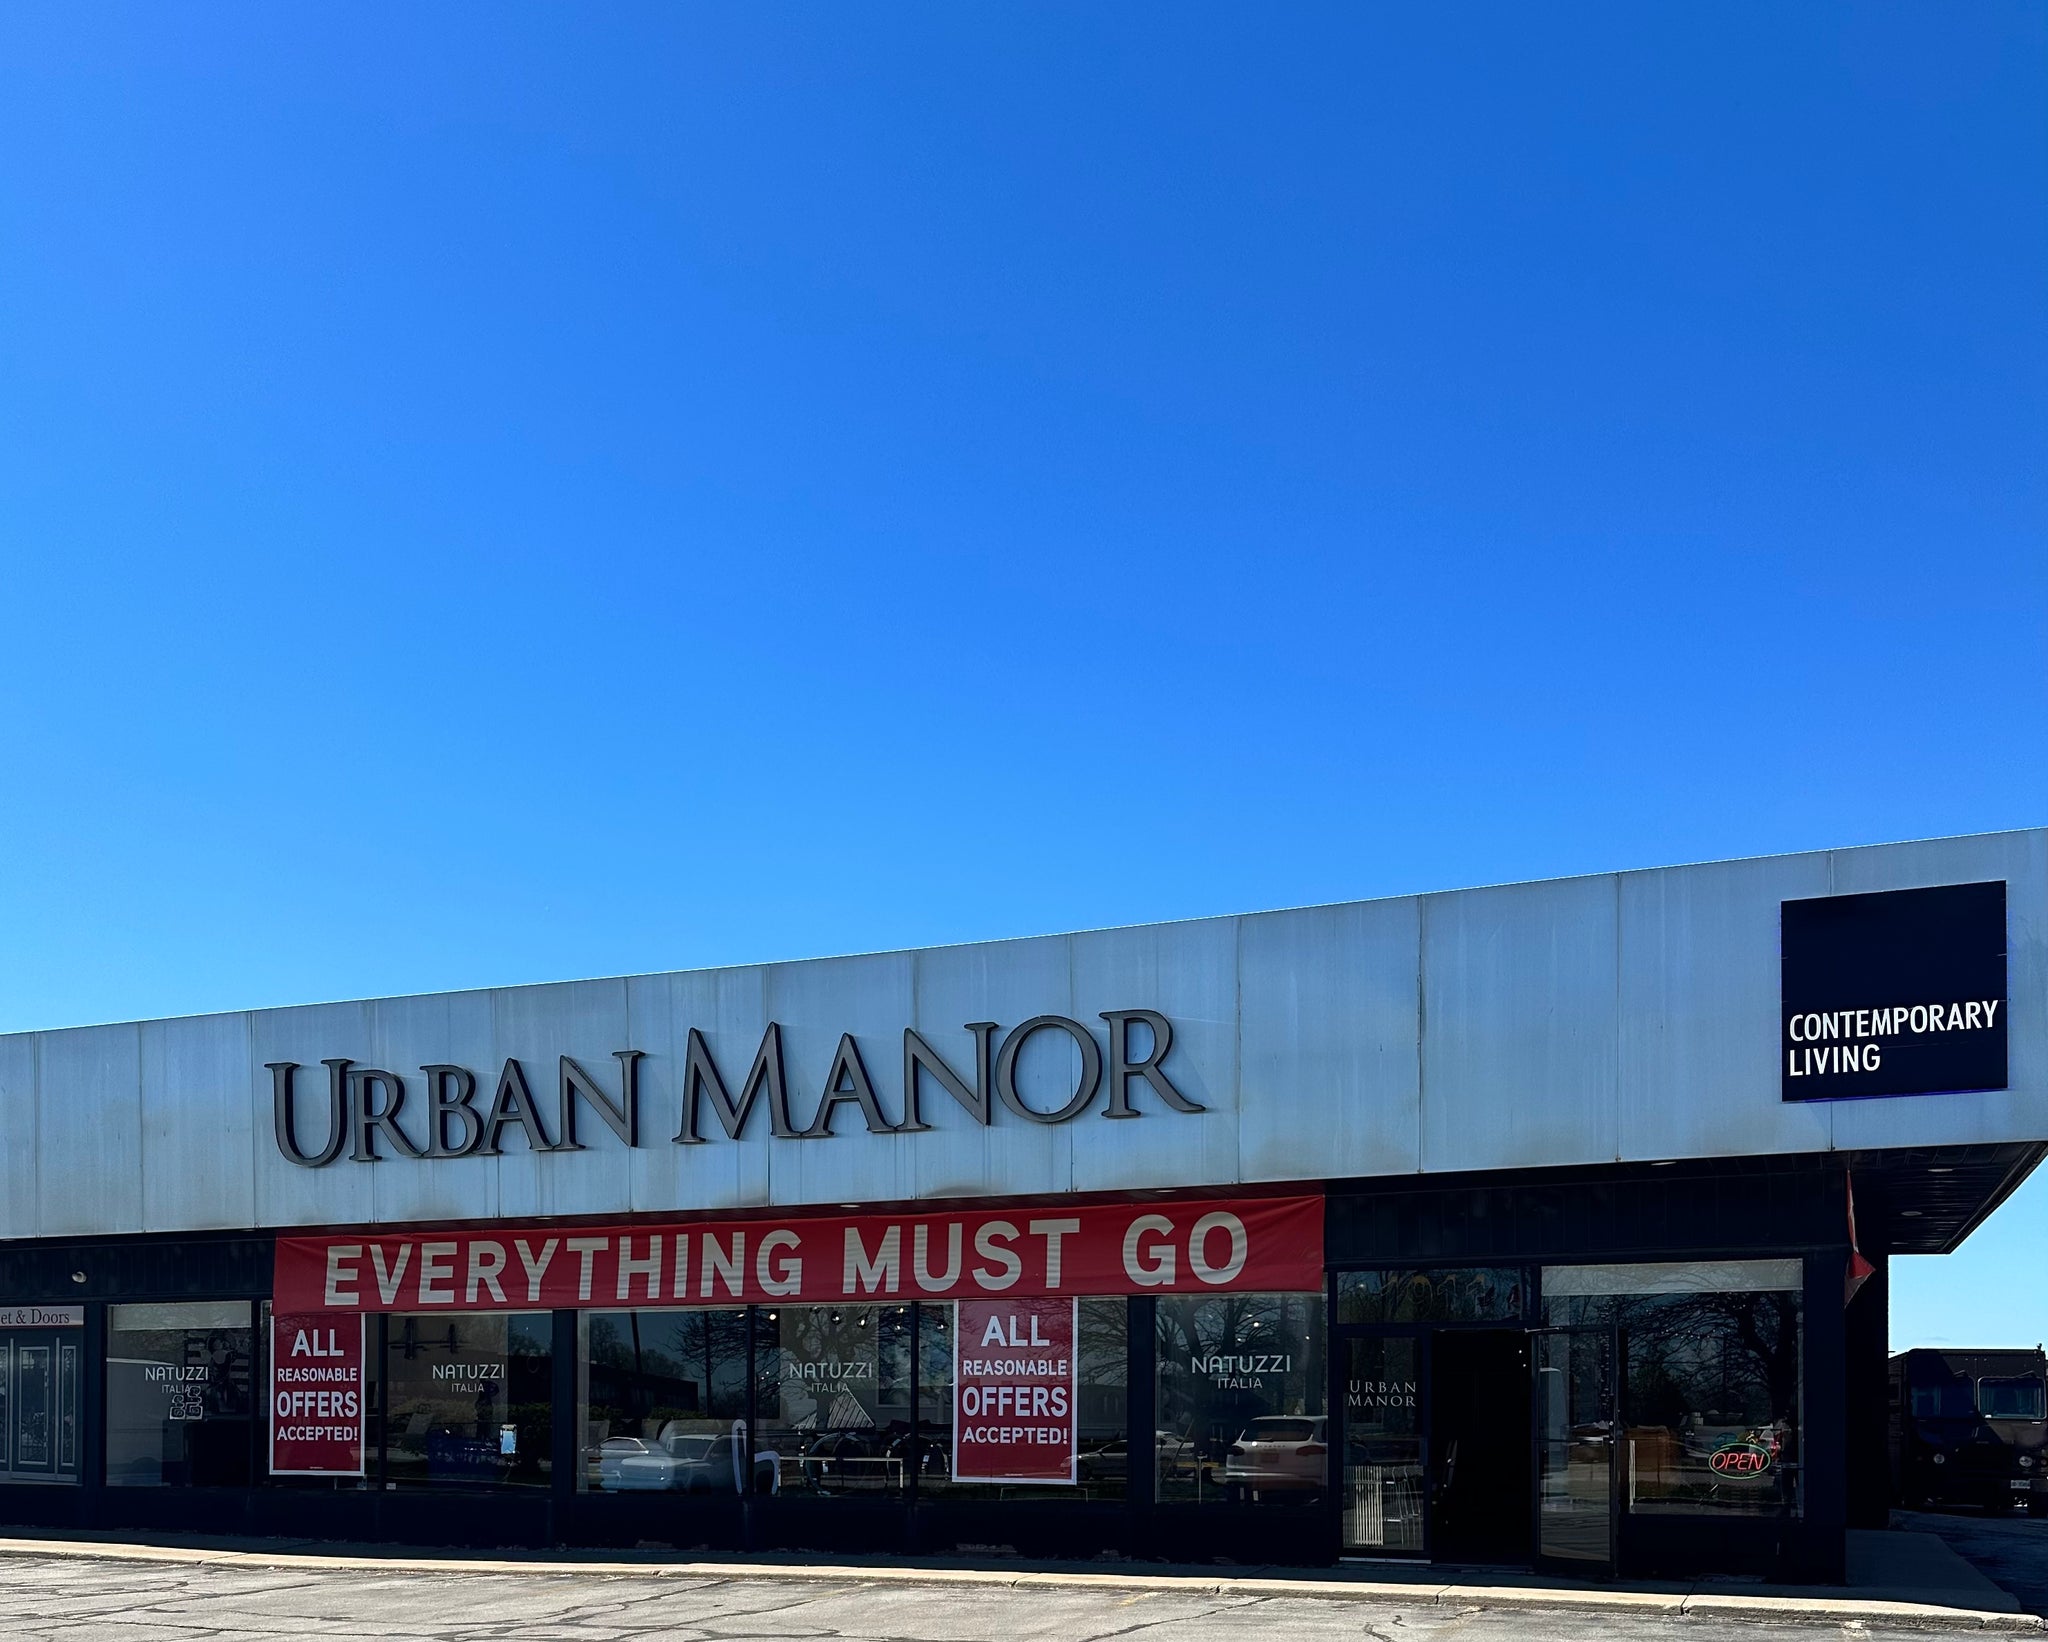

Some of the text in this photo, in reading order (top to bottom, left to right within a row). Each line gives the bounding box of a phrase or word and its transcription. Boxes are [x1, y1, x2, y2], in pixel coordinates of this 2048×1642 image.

[1789, 1000, 1998, 1042] CONTEMPORARY
[1789, 1044, 1881, 1076] LIVING
[264, 1009, 1206, 1167] URBAN MANOR
[324, 1211, 1248, 1305] EVERYTHING MUST GO
[16, 1309, 26, 1324] &
[30, 1308, 70, 1324] Doors
[980, 1315, 1050, 1347] ALL
[291, 1328, 345, 1357] ALL
[432, 1364, 505, 1380] NATUZZI
[789, 1362, 872, 1379] NATUZZI
[962, 1359, 1068, 1376] REASONABLE
[1191, 1355, 1291, 1374] NATUZZI
[145, 1366, 209, 1381] NATUZZI
[277, 1367, 358, 1382] REASONABLE
[162, 1384, 190, 1393] ITALIA
[451, 1383, 485, 1393] ITALIA
[811, 1382, 849, 1393] ITALIA
[1217, 1378, 1263, 1389] ITALIA
[1350, 1380, 1417, 1393] URBAN
[276, 1391, 358, 1418] OFFERS
[962, 1386, 1068, 1417] OFFERS
[1348, 1396, 1417, 1407] MANOR
[277, 1426, 358, 1441] ACCEPTED!
[962, 1426, 1068, 1445] ACCEPTED!
[1712, 1453, 1765, 1470] OPEN
